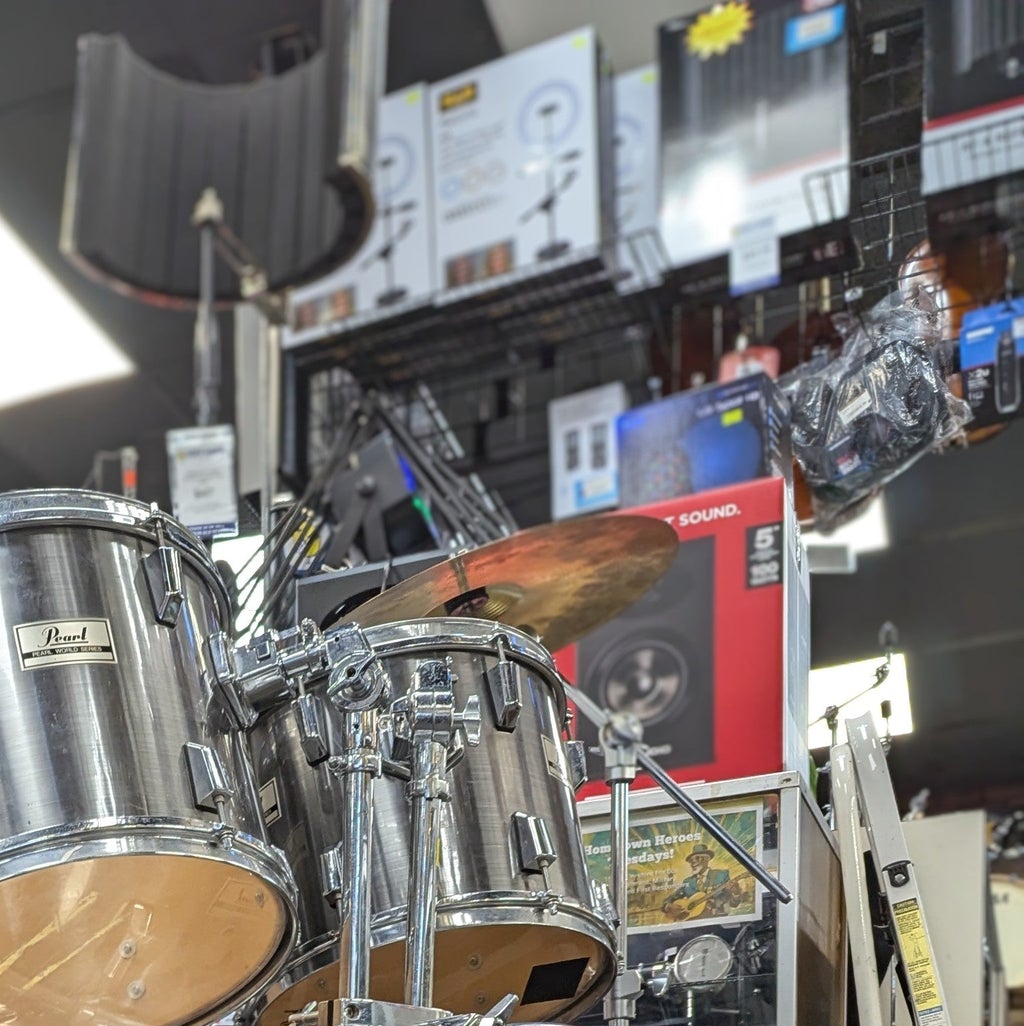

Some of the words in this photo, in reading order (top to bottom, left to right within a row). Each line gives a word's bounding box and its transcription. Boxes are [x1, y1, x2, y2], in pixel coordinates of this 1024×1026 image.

[679, 503, 742, 526] SOUND.
[37, 625, 89, 648] Pearl
[32, 649, 54, 658] PEARL
[55, 647, 79, 655] WORLD
[81, 645, 103, 653] SERIES
[584, 838, 652, 857] Homown
[655, 832, 702, 847] Heroes
